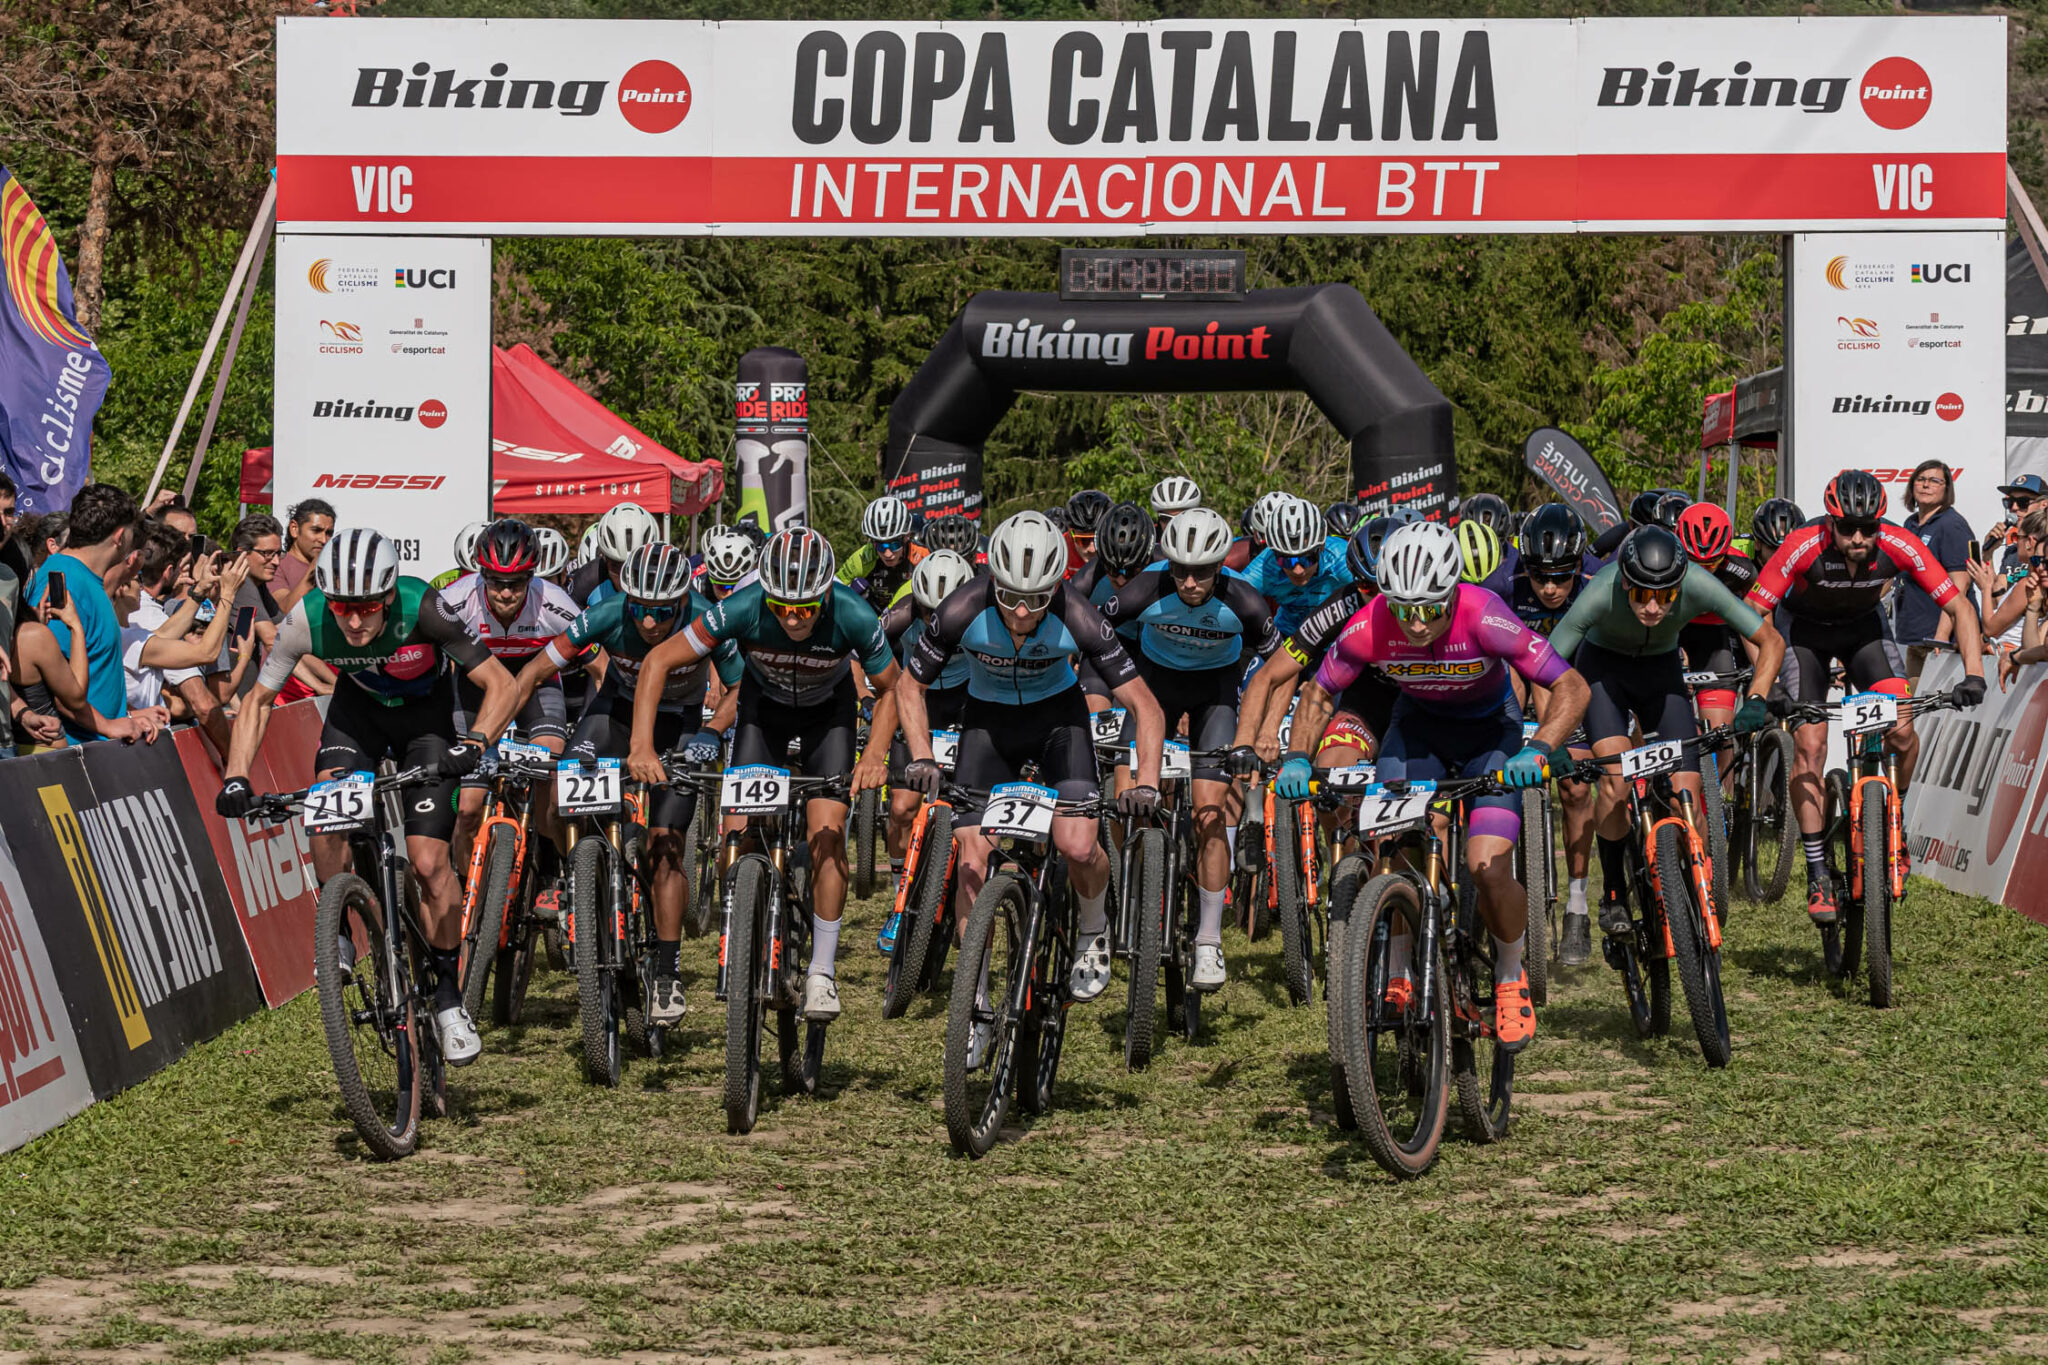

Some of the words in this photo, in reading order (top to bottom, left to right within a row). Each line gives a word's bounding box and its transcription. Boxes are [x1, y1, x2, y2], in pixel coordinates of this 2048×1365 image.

[351, 61, 610, 117] Biking
[620, 85, 688, 106] Point
[792, 29, 1016, 146] COPA
[1048, 29, 1499, 146] CATALANA
[1597, 59, 1853, 114] Biking
[1862, 83, 1930, 103] Point
[351, 165, 413, 214] VIC
[789, 161, 1346, 219] INTERNACIONAL
[1376, 161, 1501, 217] BTT
[1872, 163, 1933, 212] VIC
[406, 268, 456, 289] UCI
[1921, 263, 1971, 283] UCI
[319, 346, 364, 354] CICLISMO
[402, 345, 446, 356] esportcat
[982, 317, 1135, 366] Biking
[1145, 321, 1272, 361] Point
[1837, 342, 1881, 350] CICLISMO
[1919, 340, 1962, 350] esportcat
[770, 386, 807, 402] PRO
[1831, 394, 1933, 416] Biking
[312, 398, 415, 422] Biking
[419, 409, 446, 418] Point
[1935, 402, 1963, 411] Point
[920, 478, 960, 495] Point
[1390, 463, 1443, 489] Biking
[534, 483, 587, 497] SINCE
[599, 481, 642, 497] 1934
[1391, 481, 1434, 505] Point
[323, 649, 424, 667] cannondale
[1387, 660, 1484, 676] X-SAUCE
[1855, 704, 1884, 726] 54
[1628, 746, 1674, 771] 150
[566, 775, 611, 803] 221
[730, 780, 780, 804] 149
[1001, 785, 1048, 797] SHIMANO
[312, 790, 364, 821] 215
[997, 801, 1037, 827] 37
[1375, 797, 1414, 823] 27
